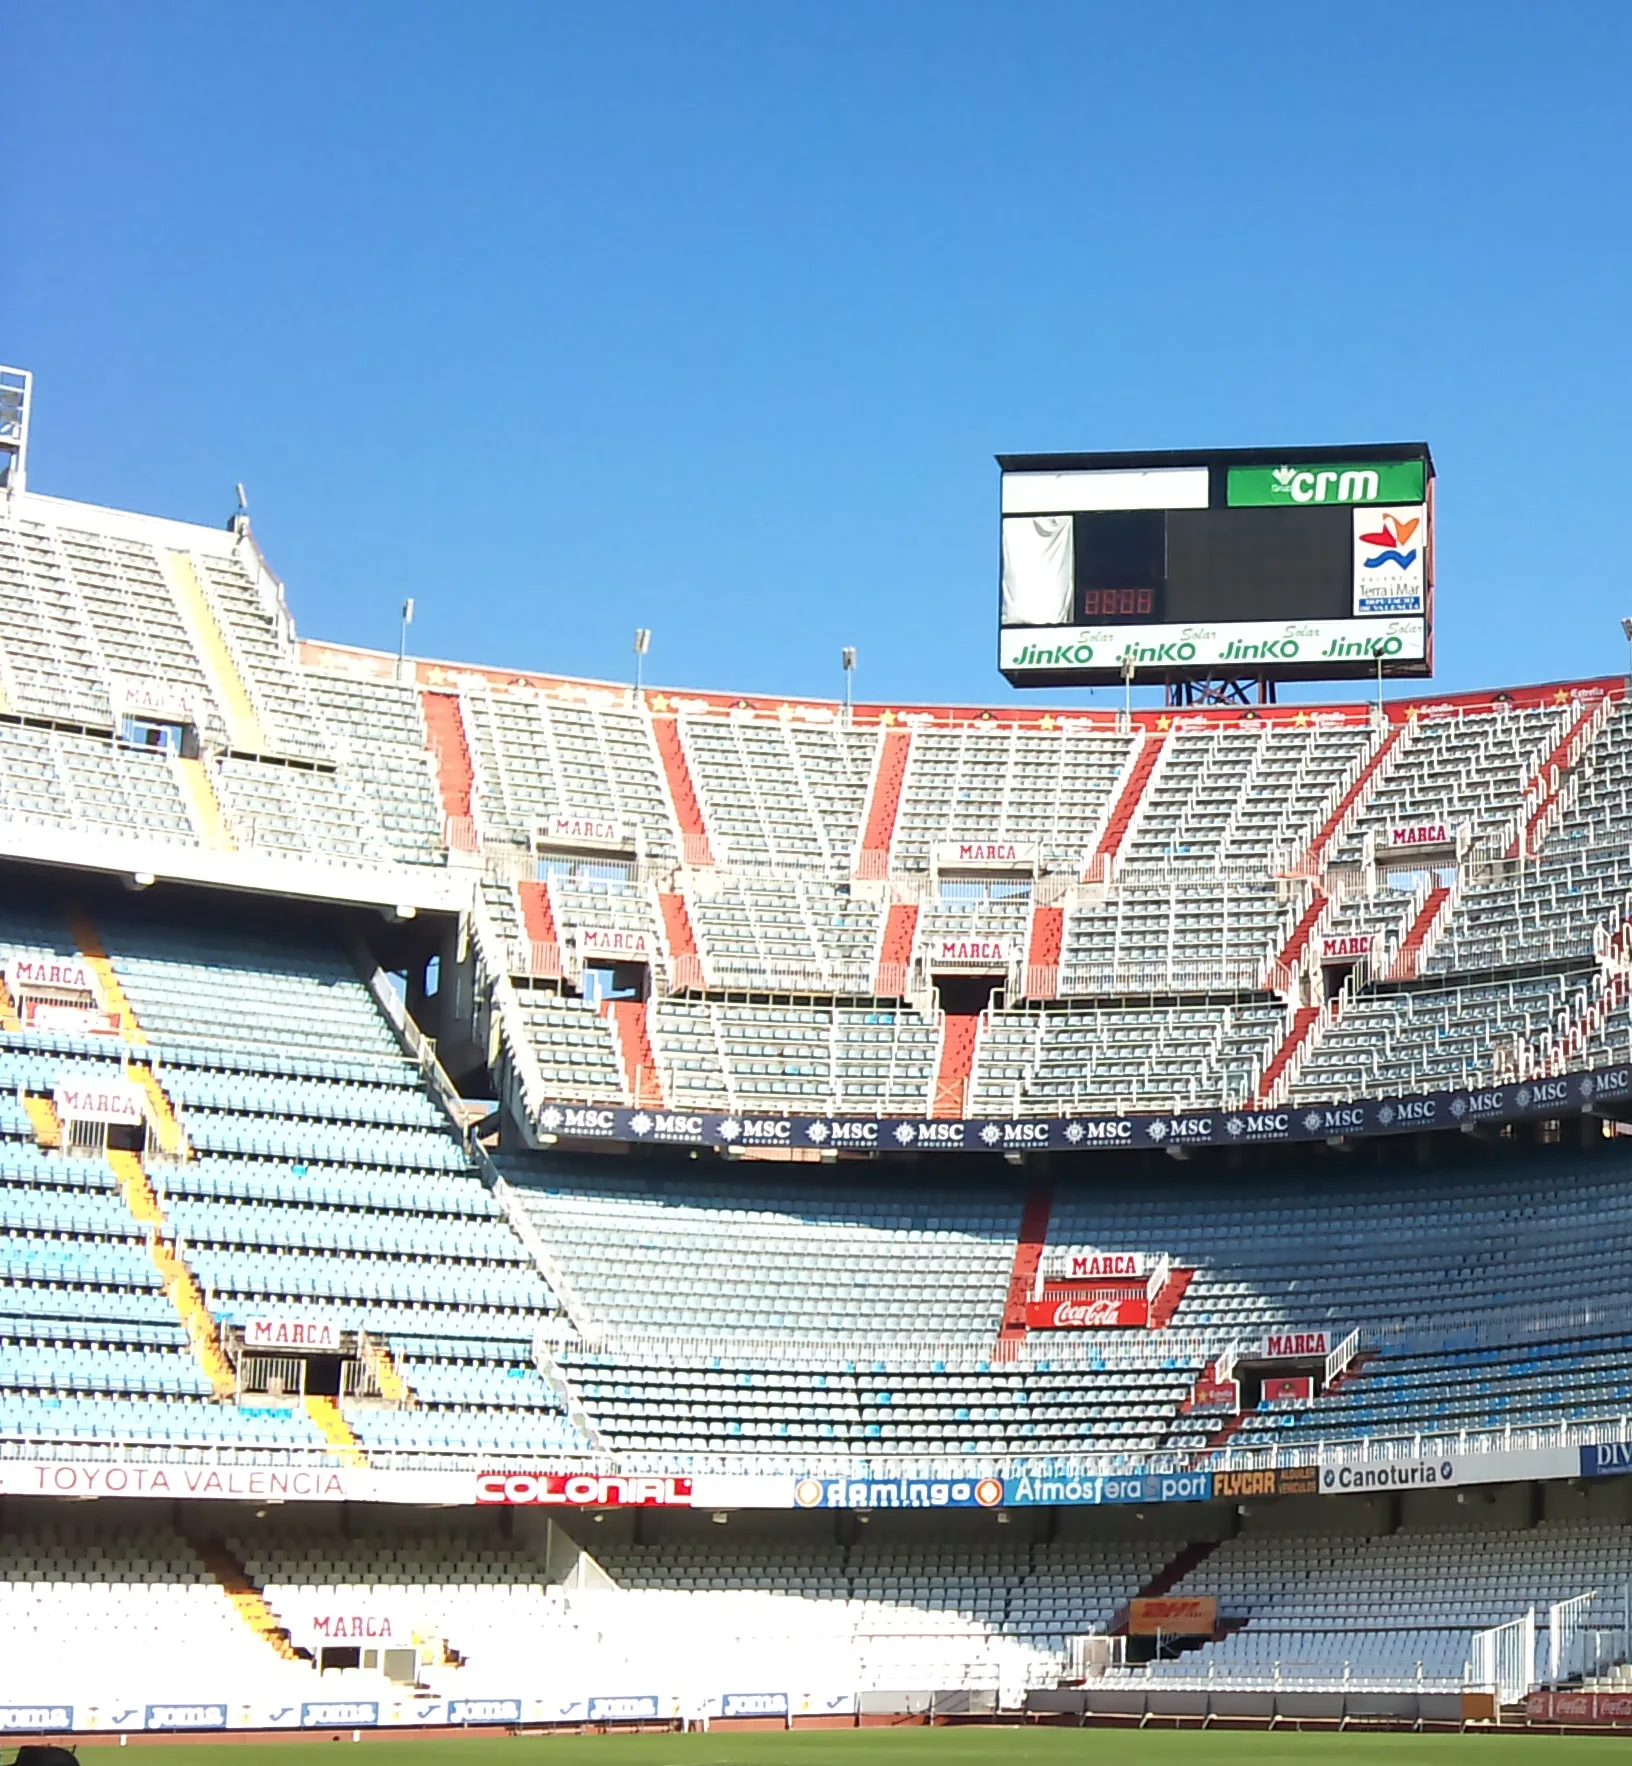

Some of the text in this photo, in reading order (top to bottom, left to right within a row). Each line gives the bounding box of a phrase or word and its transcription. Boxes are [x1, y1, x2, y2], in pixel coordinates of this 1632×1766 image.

[1291, 470, 1379, 502] crm
[1359, 584, 1388, 596] Terra
[1396, 583, 1420, 596] Mar
[1078, 630, 1115, 645] Solar
[1180, 628, 1217, 643] Solar
[1283, 624, 1321, 640] Solar
[1386, 621, 1423, 636] Solar
[556, 819, 615, 839] MARCA
[1392, 825, 1448, 845] MARCA
[959, 844, 1017, 860] MARCA
[583, 930, 646, 951] MARCA
[941, 942, 1002, 959] MARCA
[15, 961, 87, 985] MARCA
[1596, 1070, 1629, 1092] MSC
[1533, 1081, 1567, 1102] MSC
[64, 1090, 136, 1116] MARCA
[1397, 1100, 1436, 1120] MSC
[1469, 1092, 1503, 1112] MSC
[565, 1109, 614, 1129] MSC
[654, 1114, 703, 1134] MSC
[1170, 1118, 1212, 1136] MSC
[1246, 1114, 1289, 1132] MSC
[1324, 1108, 1364, 1127] MSC
[742, 1119, 791, 1138] MSC
[830, 1122, 879, 1140] MSC
[917, 1123, 965, 1140] MSC
[1004, 1123, 1049, 1141] MSC
[1087, 1121, 1132, 1139] MSC
[1071, 1255, 1137, 1275] MARCA
[1053, 1300, 1124, 1327] Coca-Cola
[254, 1321, 332, 1344] MARCA
[1266, 1332, 1327, 1356] MARCA
[34, 1466, 347, 1495] TOYOTA VALENCIA
[1213, 1471, 1276, 1497] FLYCAR
[1338, 1461, 1437, 1489] Canoturia
[475, 1476, 692, 1504] COLONIAL
[827, 1478, 971, 1506] domingo
[1016, 1471, 1142, 1504] Atmósfera
[312, 1616, 393, 1638] MARCA
